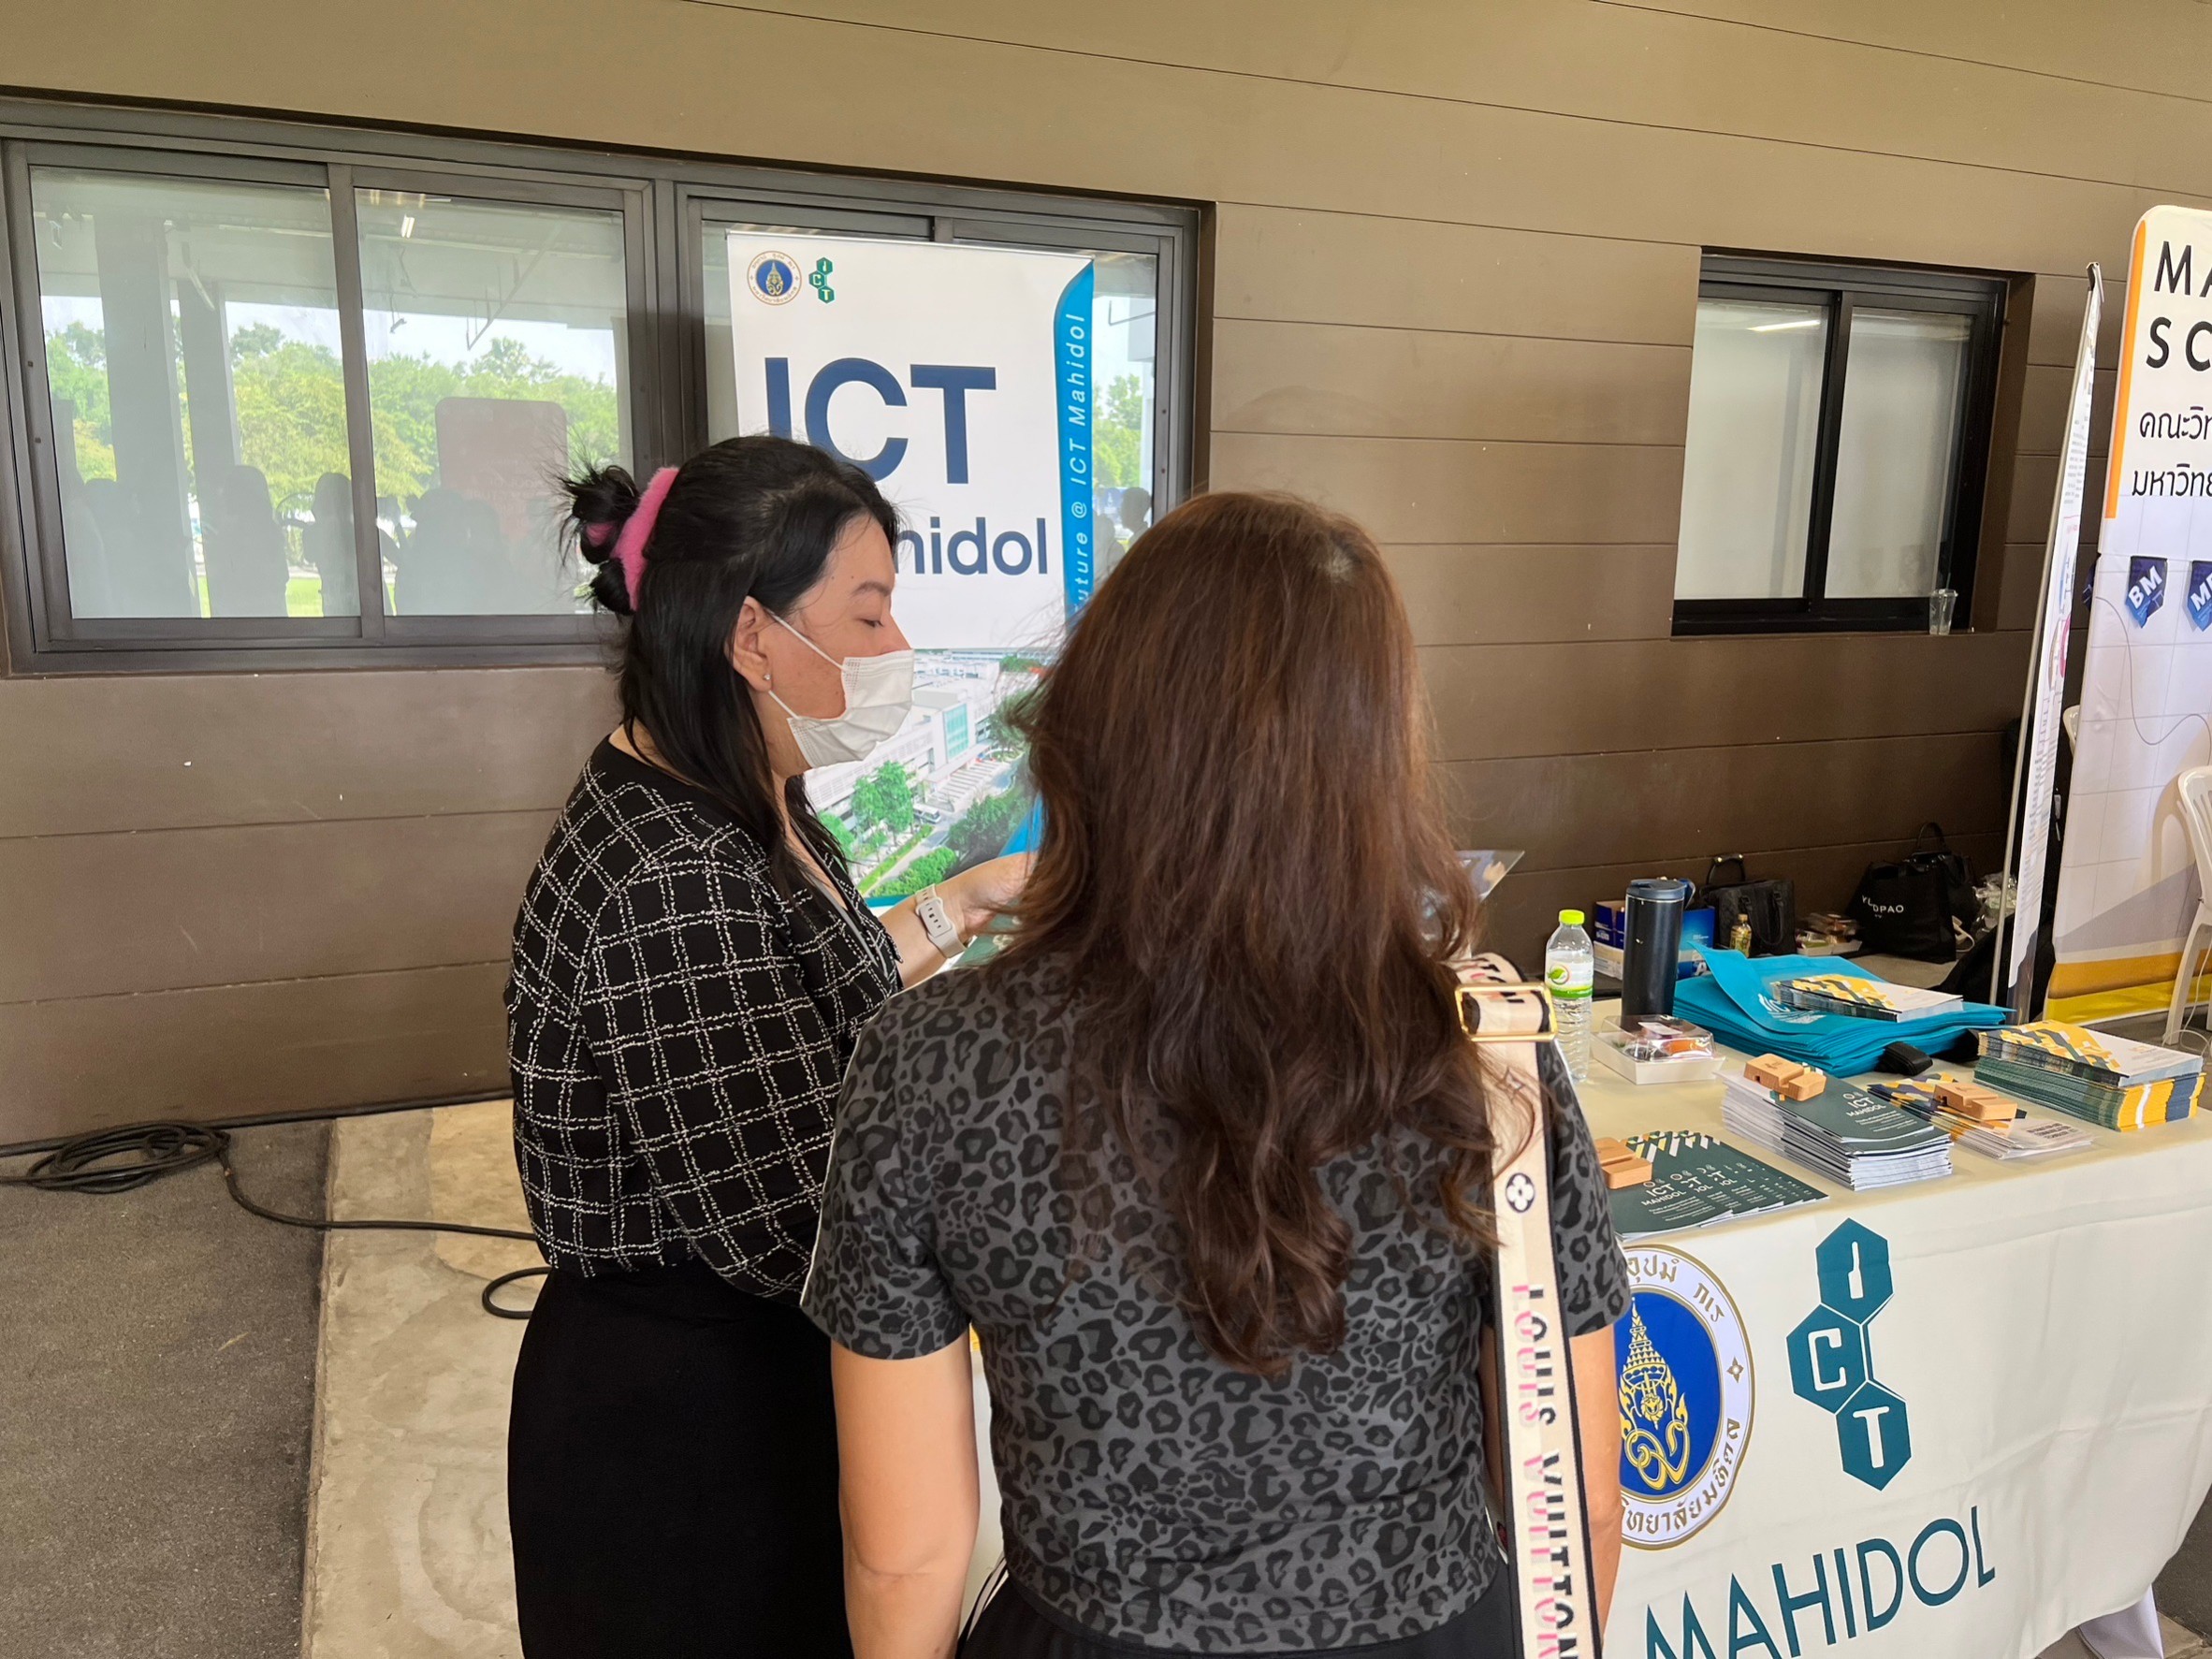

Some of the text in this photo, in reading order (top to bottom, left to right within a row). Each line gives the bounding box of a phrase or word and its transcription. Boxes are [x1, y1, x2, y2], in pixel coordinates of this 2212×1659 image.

[764, 357, 997, 484] ICT
[1066, 313, 1089, 613] uture @ ICT Mahidol
[2128, 565, 2162, 609] BM
[2190, 572, 2212, 612] M
[1847, 1097, 1875, 1110] ICT
[1640, 1190, 1687, 1207] MAHIDOL
[1646, 1183, 1677, 1198] ICT
[1512, 1285, 1579, 1659] LOUIS VUITTON
[1646, 1505, 1996, 1659] MAHIDOL
